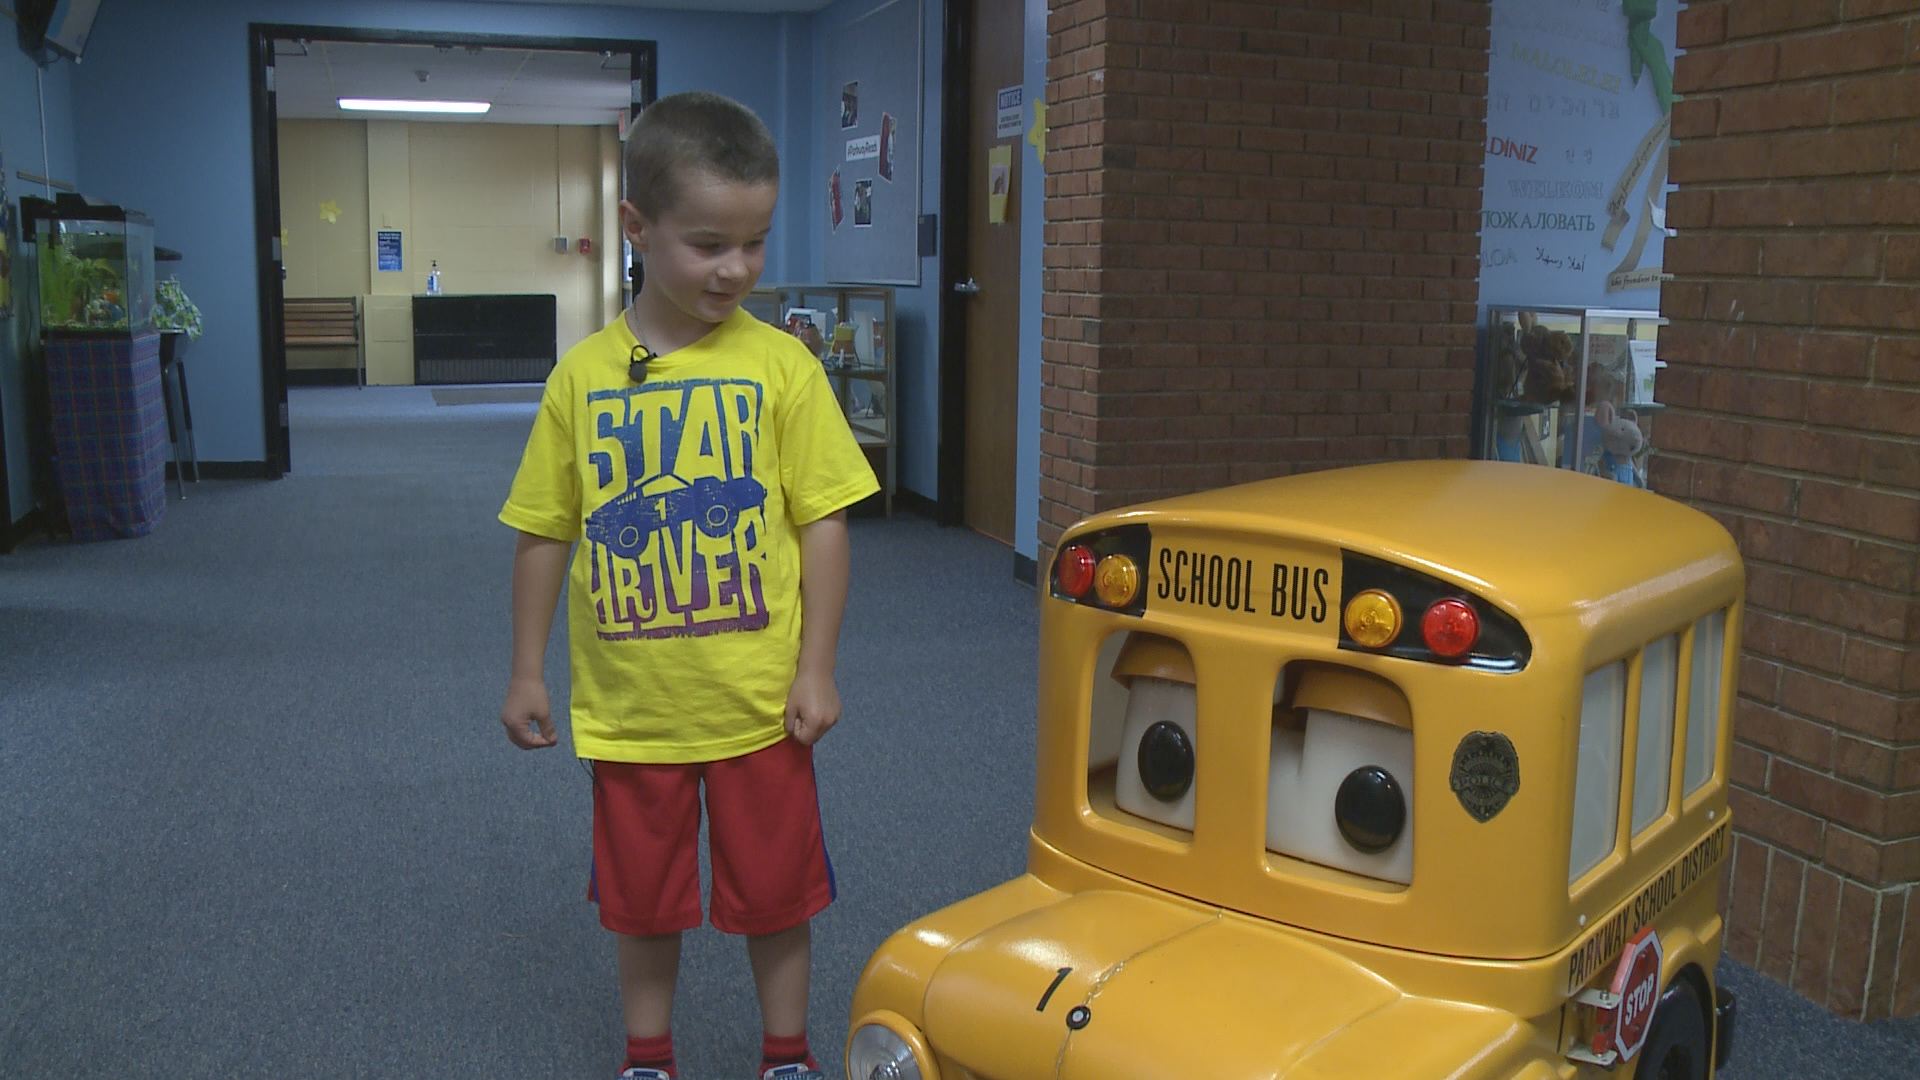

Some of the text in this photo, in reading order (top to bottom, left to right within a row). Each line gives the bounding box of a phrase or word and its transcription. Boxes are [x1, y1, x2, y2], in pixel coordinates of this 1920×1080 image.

[586, 379, 764, 500] STAR
[1157, 547, 1329, 623] SCHOOL BUS
[1567, 823, 1727, 993] PARKWAY SCHOOL DISTRICT
[1624, 973, 1655, 1025] STOP
